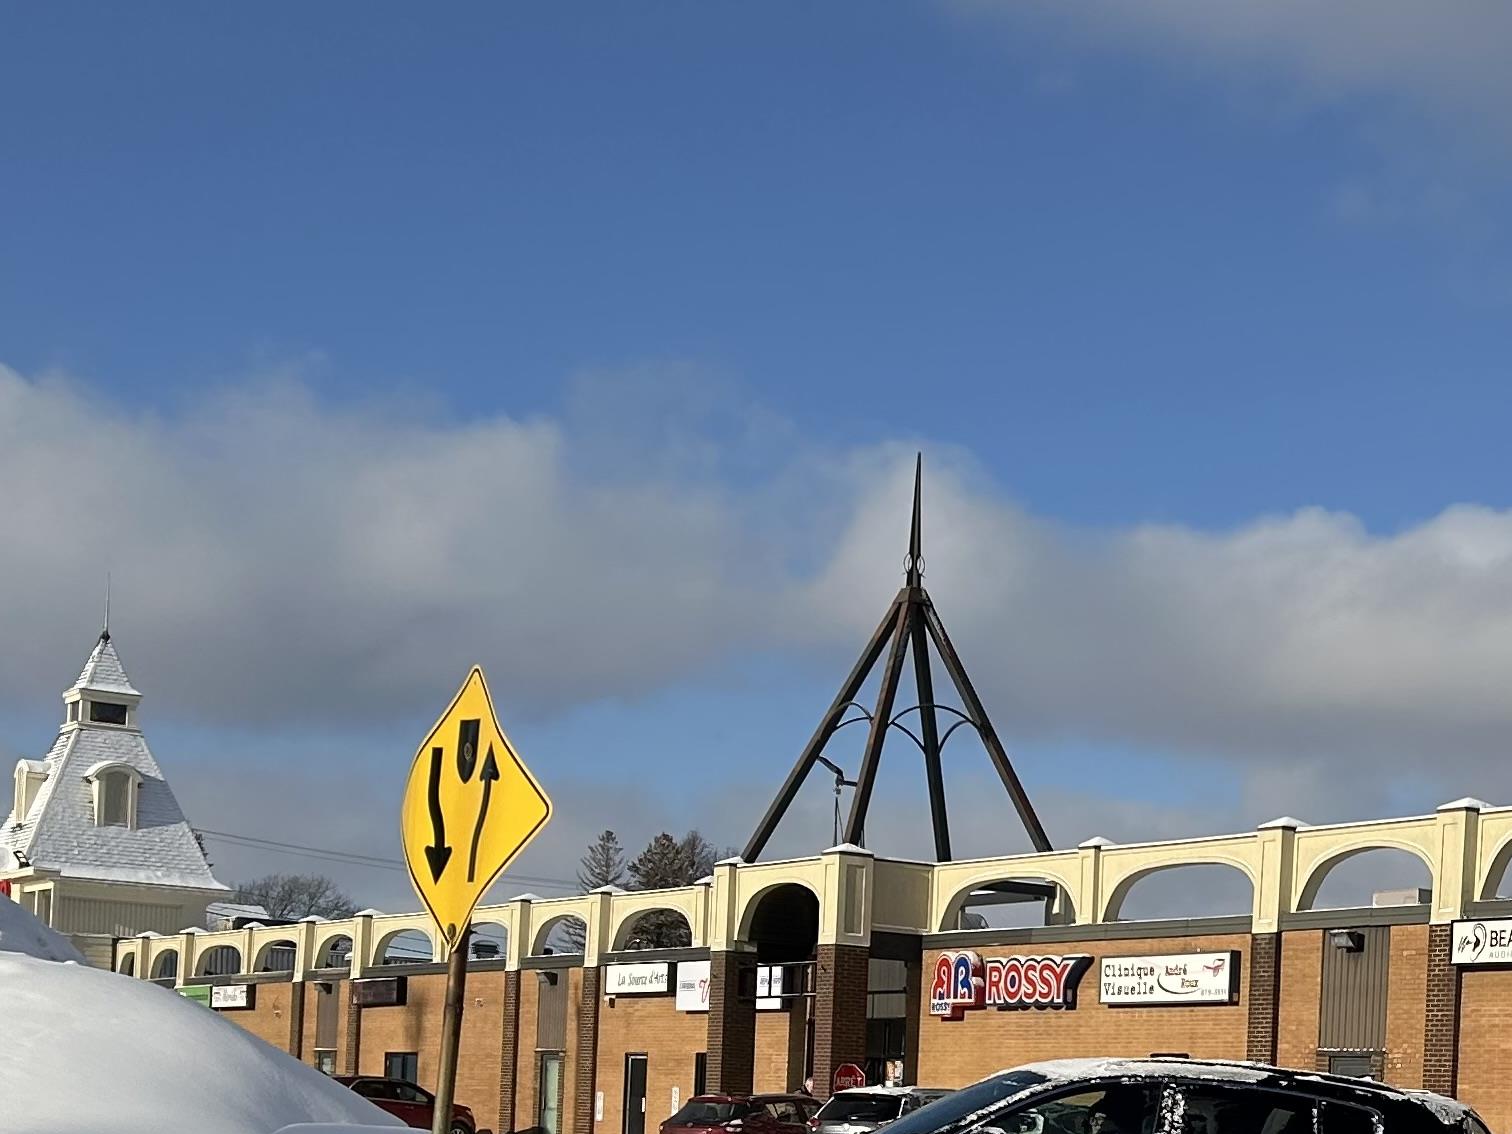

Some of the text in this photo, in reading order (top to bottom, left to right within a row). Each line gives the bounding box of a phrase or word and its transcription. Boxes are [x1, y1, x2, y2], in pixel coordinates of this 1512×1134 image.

[617, 972, 626, 986] La
[1104, 964, 1155, 980] Clinique
[986, 958, 1077, 1004] ROSSY
[1104, 982, 1155, 996] Visuelle
